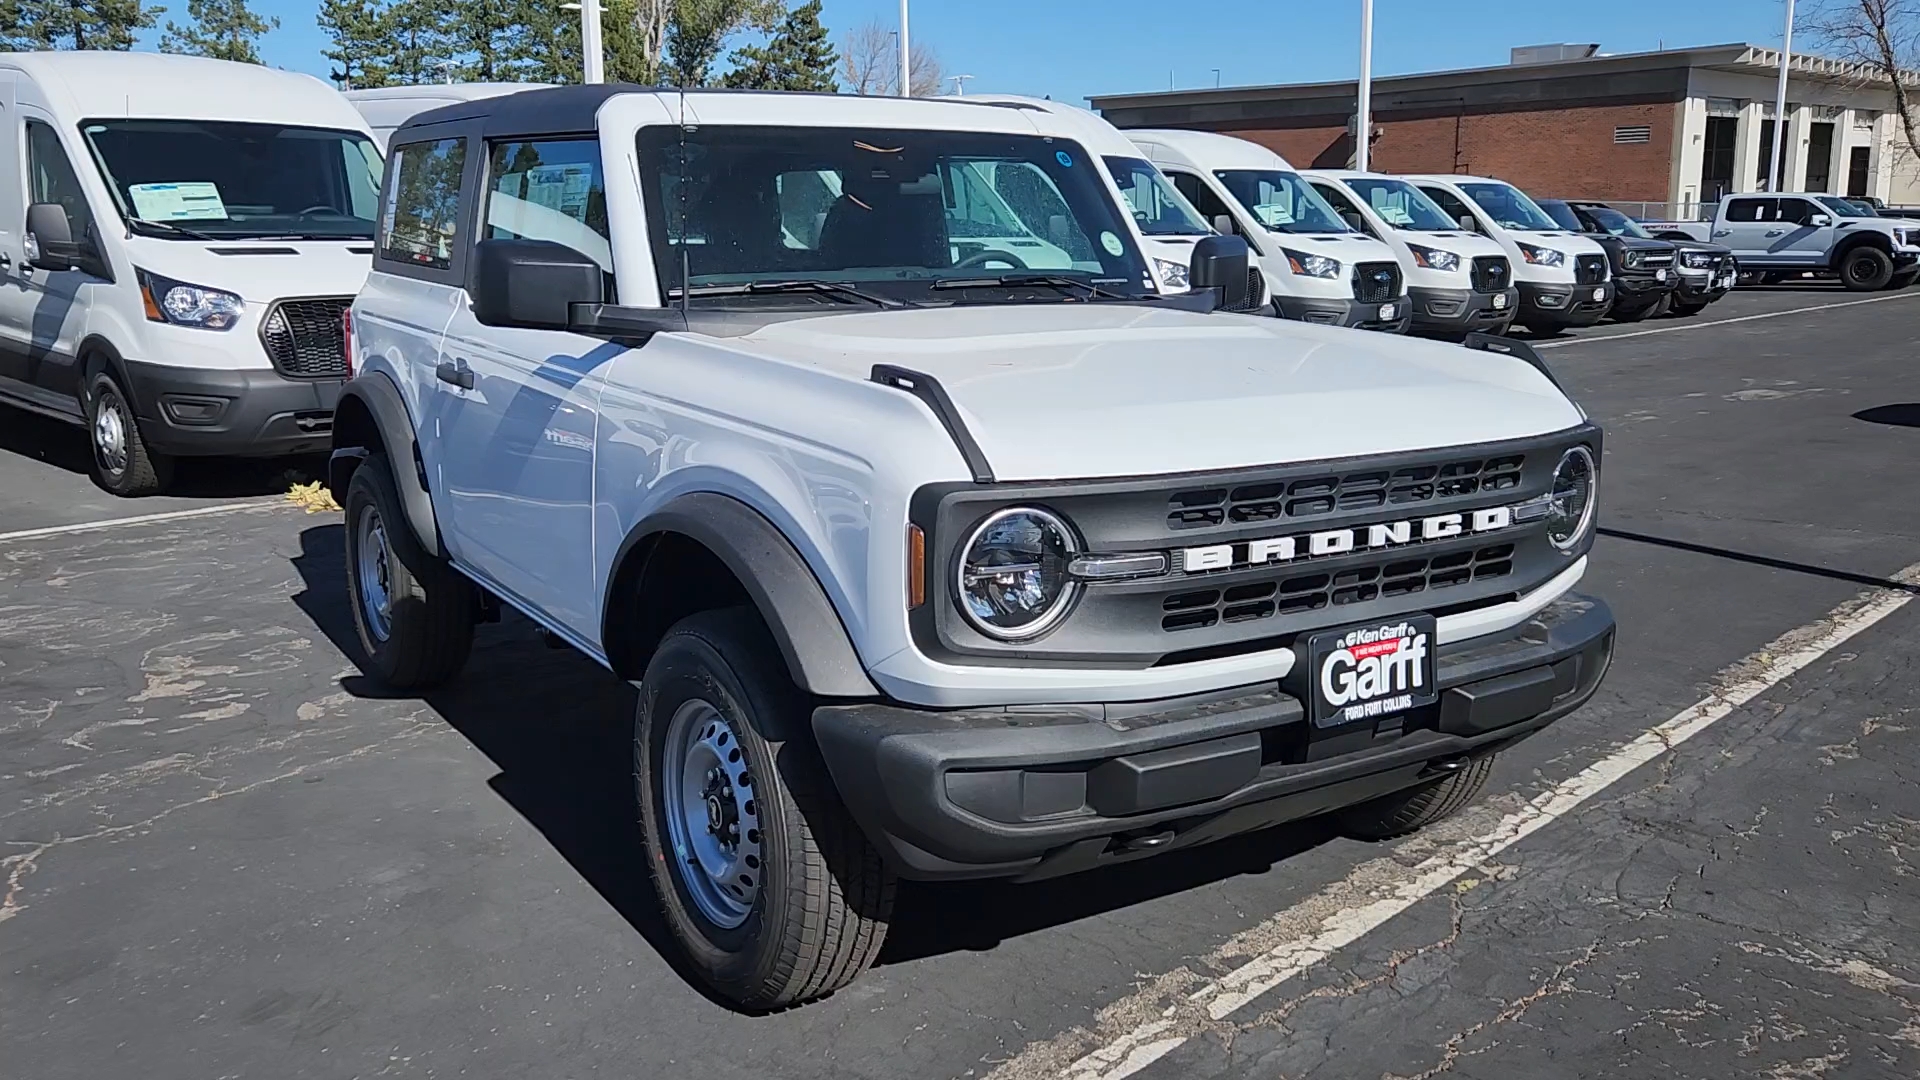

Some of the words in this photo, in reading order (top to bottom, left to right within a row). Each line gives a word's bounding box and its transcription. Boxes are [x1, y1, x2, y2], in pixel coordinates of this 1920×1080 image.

[1183, 506, 1510, 572] BRONCO
[1356, 629, 1379, 645] Ken
[1379, 622, 1408, 641] Garff
[1321, 633, 1426, 706] Garff
[1345, 705, 1364, 721] FORD
[1364, 700, 1382, 717] FORT
[1383, 694, 1412, 713] COLLINS
